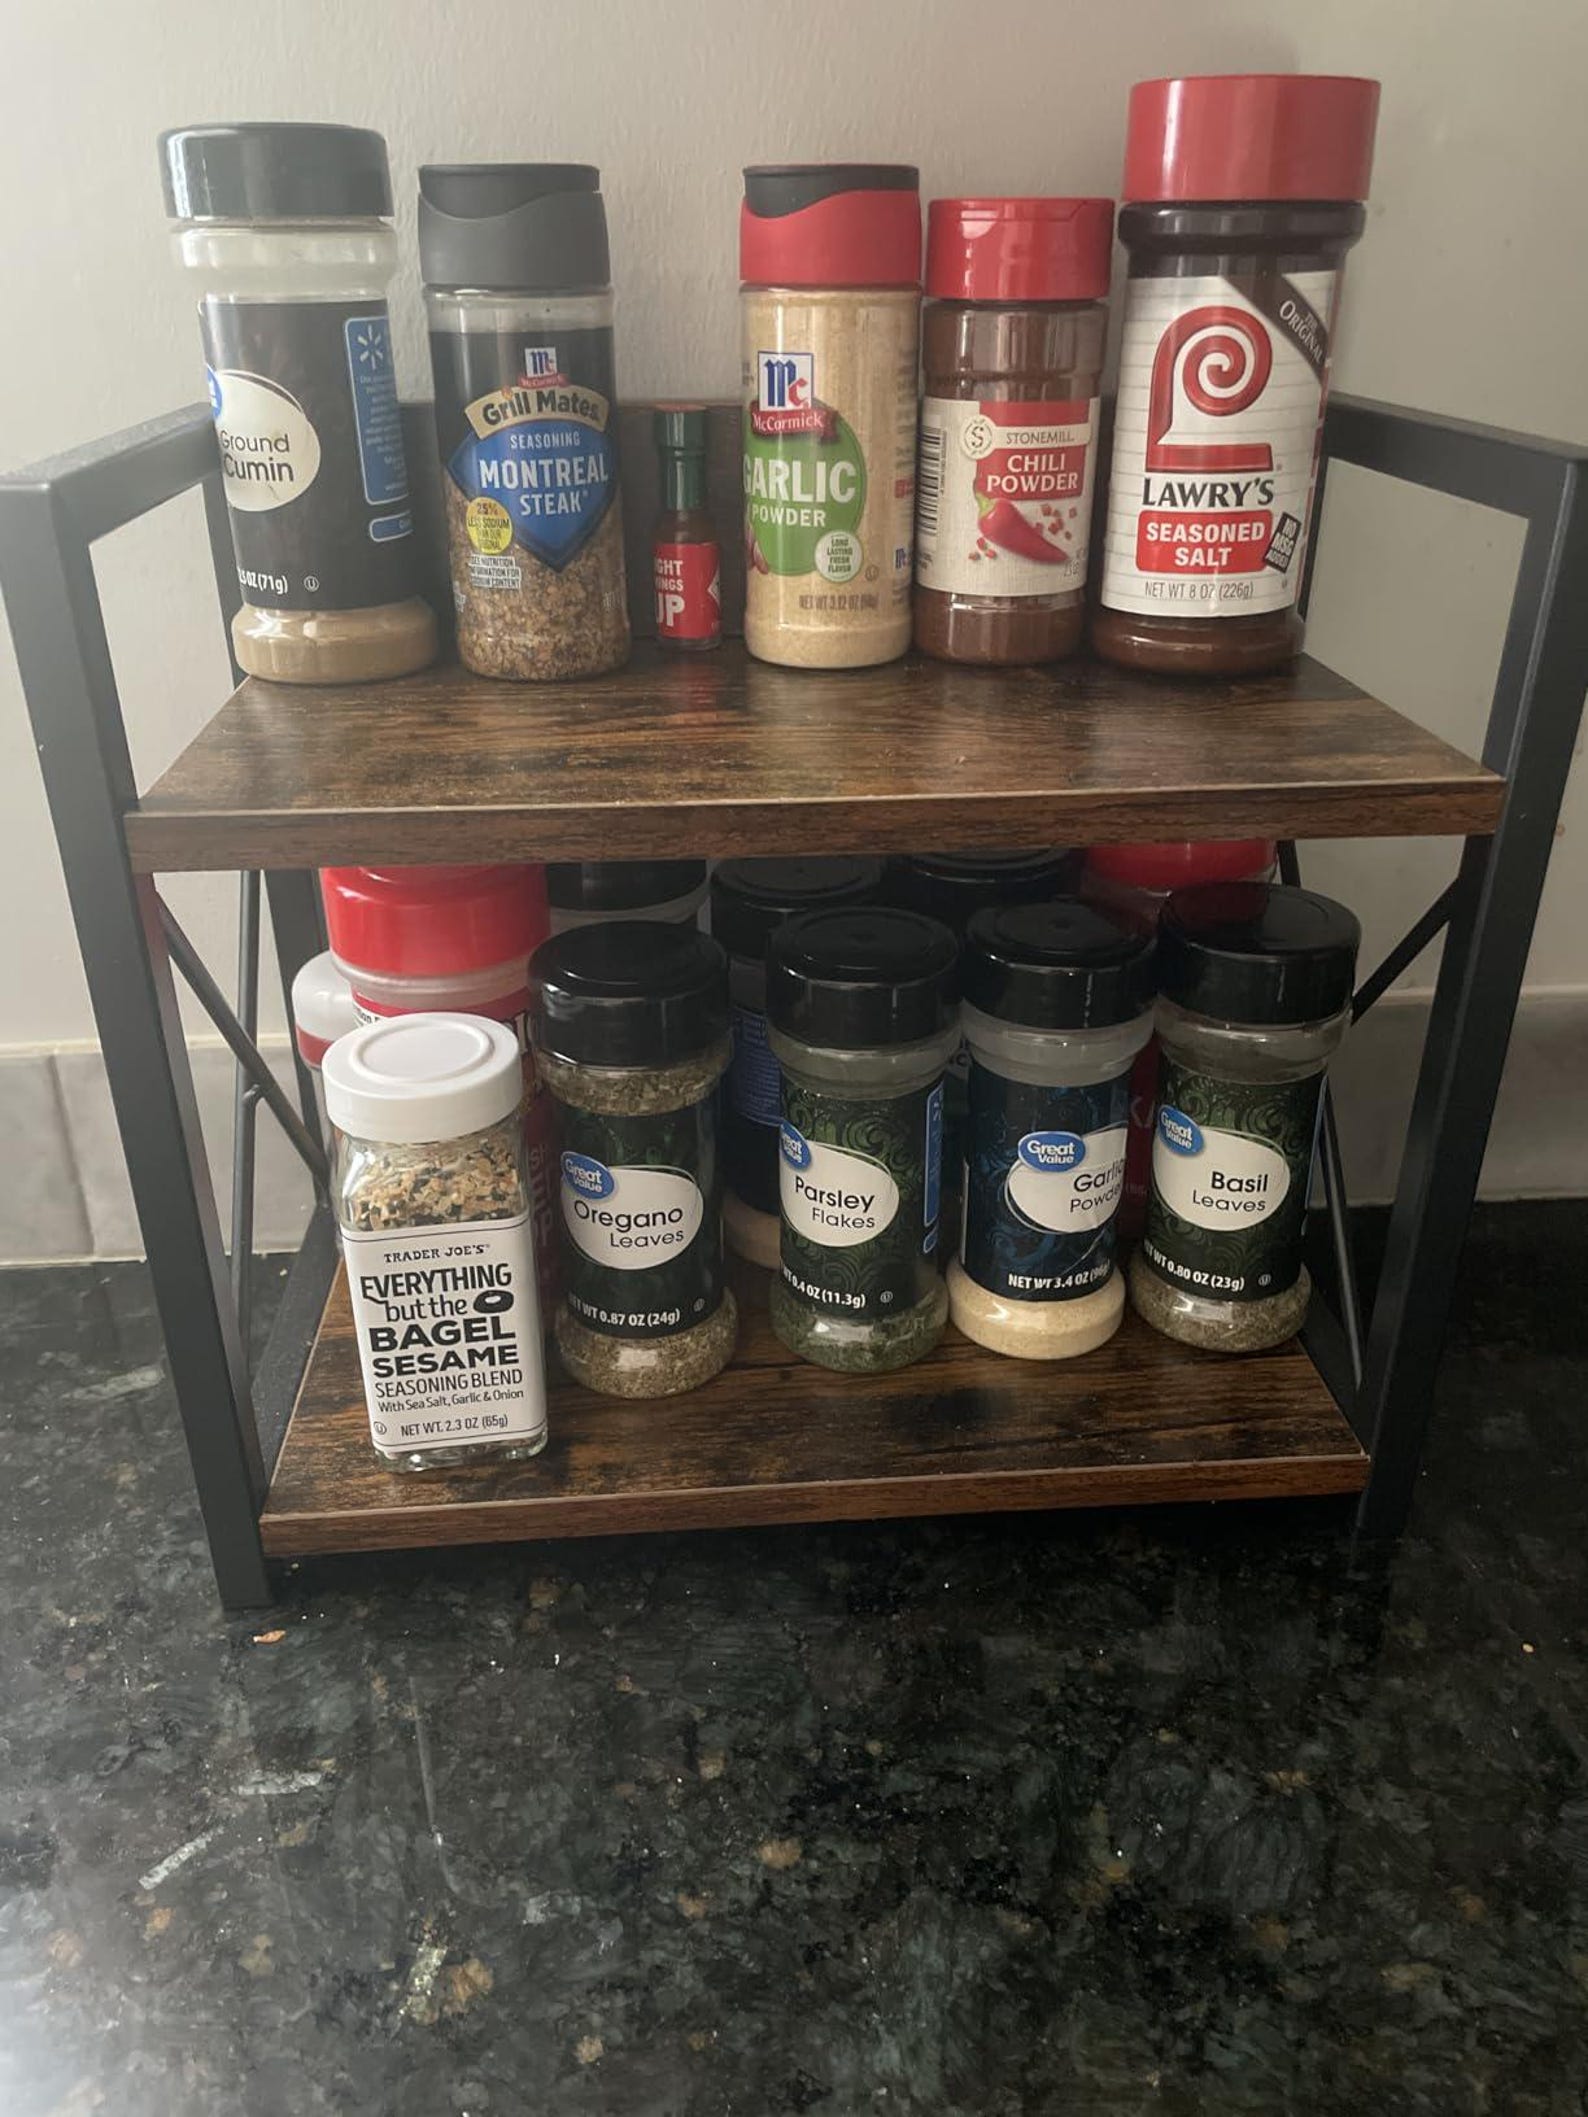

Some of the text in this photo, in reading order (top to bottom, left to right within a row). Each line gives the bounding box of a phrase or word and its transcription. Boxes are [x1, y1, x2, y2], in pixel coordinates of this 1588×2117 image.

[482, 390, 599, 425] Grill Mates
[752, 413, 824, 431] McCormick
[220, 429, 290, 452] Ground
[510, 431, 581, 449] SEASONING
[1006, 430, 1074, 444] STONEMILL
[223, 452, 295, 482] Cumin
[479, 453, 609, 489] MONTREAL
[1007, 453, 1066, 473] CHILI
[743, 454, 856, 503] GARLIC
[987, 473, 1078, 493] POWDER
[520, 491, 582, 516] STEAK
[1142, 477, 1274, 508] LAWRY'S
[752, 503, 826, 527] POWDER
[1146, 521, 1265, 543] SEASONED
[1175, 547, 1232, 566] SALT
[257, 573, 288, 595] (71g)
[1145, 582, 1167, 599] NET
[1169, 582, 1186, 599] WT
[1189, 582, 1196, 598] 8
[1219, 581, 1254, 600] (226g)
[1161, 1112, 1192, 1139] Great
[1027, 1140, 1075, 1155] Great
[1037, 1154, 1073, 1164] Value
[565, 1158, 603, 1184] Great
[1211, 1171, 1268, 1193] Basil
[574, 1176, 603, 1193] Value
[795, 1175, 875, 1213] Parsley
[1192, 1190, 1266, 1212] Leaves
[574, 1200, 683, 1233] Oregano
[812, 1207, 875, 1229] Flakes
[610, 1230, 684, 1248] Leaves
[384, 1244, 485, 1263] TRADER JOE'S
[360, 1263, 512, 1301] EVERYTHING
[1008, 1274, 1031, 1289] NET
[1034, 1277, 1051, 1289] WT
[1054, 1275, 1073, 1289] 3.4
[1074, 1271, 1089, 1285] OZ
[1153, 1250, 1167, 1268] WT
[1167, 1262, 1191, 1280] 0.80
[1193, 1271, 1209, 1284] OZ
[1211, 1274, 1245, 1291] (23g)
[792, 1276, 805, 1293] 0.4
[806, 1283, 820, 1300] OZ
[822, 1289, 866, 1309] (11.3g)
[385, 1294, 468, 1322] but the
[582, 1302, 598, 1319] WT
[600, 1309, 626, 1325] 0.87
[629, 1314, 645, 1327] OZ
[647, 1308, 681, 1327] (24g)
[369, 1316, 516, 1352] BAGEL
[372, 1344, 519, 1378] SESAME
[375, 1369, 523, 1398] SEASONING BLEND
[378, 1388, 524, 1413] With Sea Salt, Garlic & Onion
[400, 1414, 508, 1437] NET WT. 2.3 OZ (65g)
